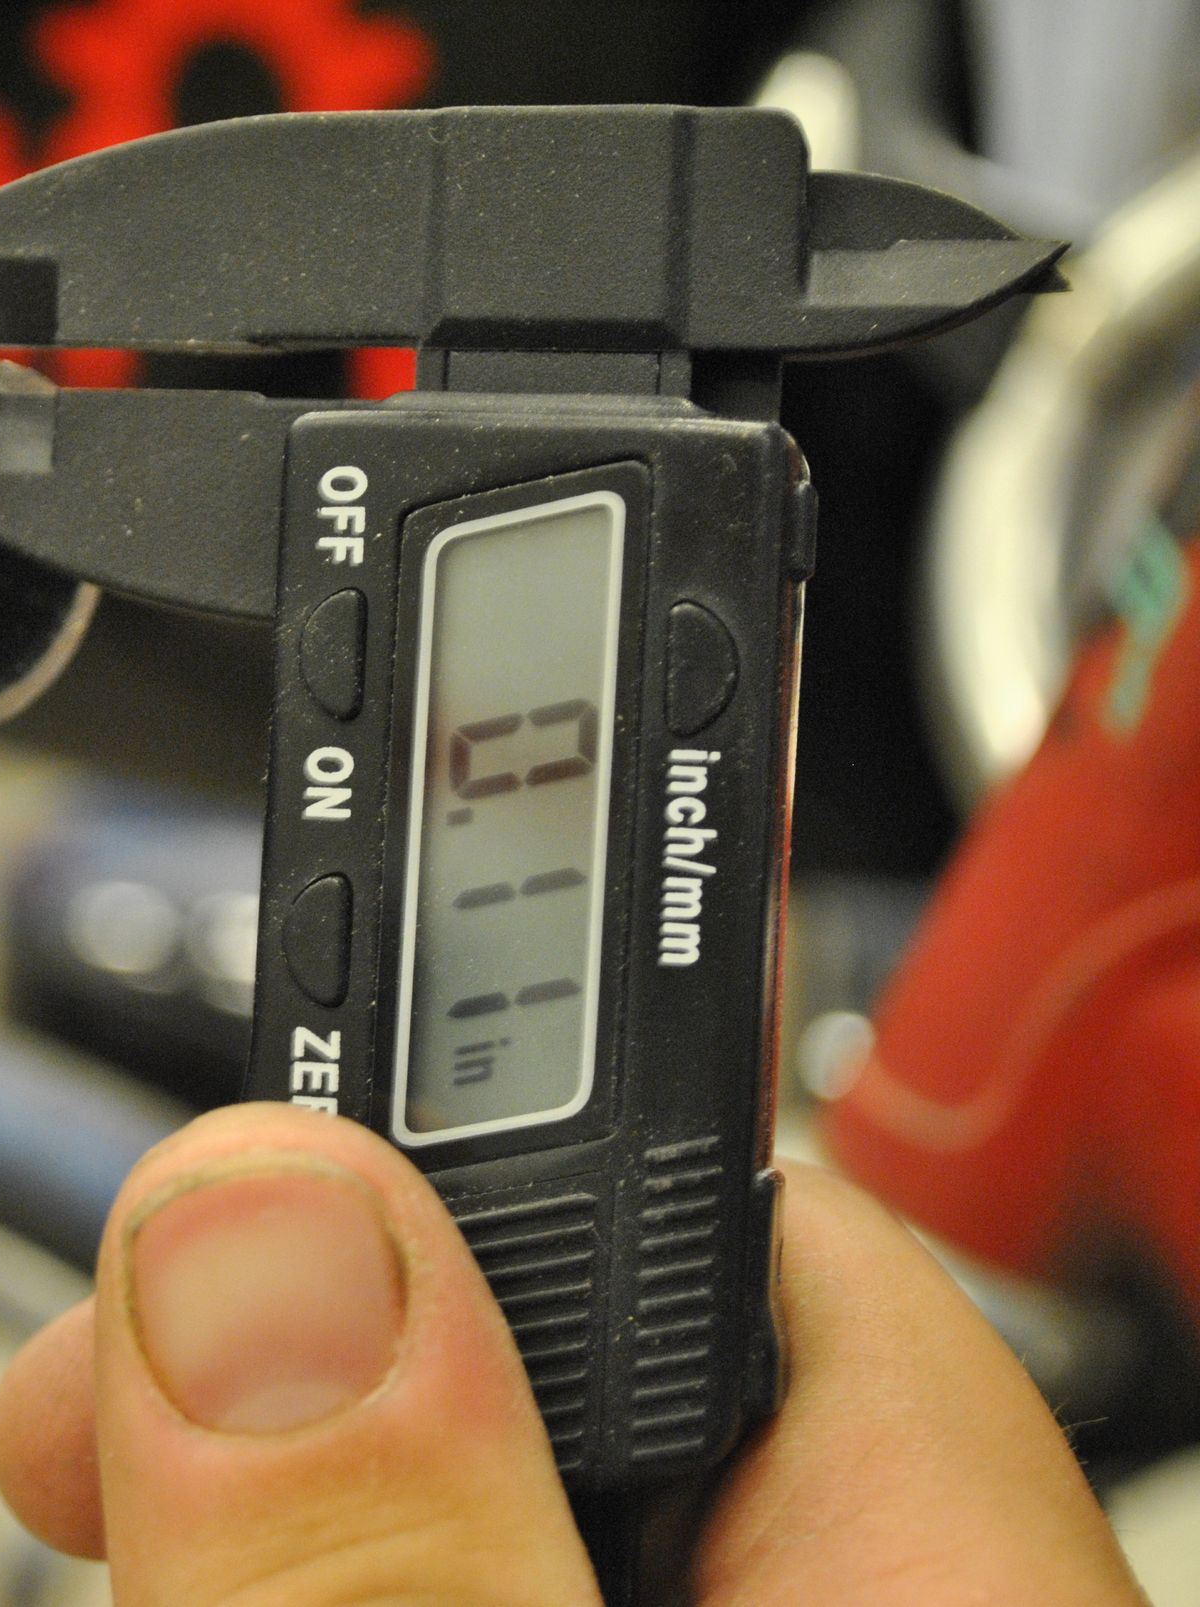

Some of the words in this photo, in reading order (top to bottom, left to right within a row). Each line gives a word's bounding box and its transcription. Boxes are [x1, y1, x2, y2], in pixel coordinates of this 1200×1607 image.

[318, 465, 368, 566] OFF
[304, 746, 355, 821] ON
[446, 698, 598, 1020] 0.11
[658, 749, 722, 967] inch/mm
[453, 1036, 511, 1087] in
